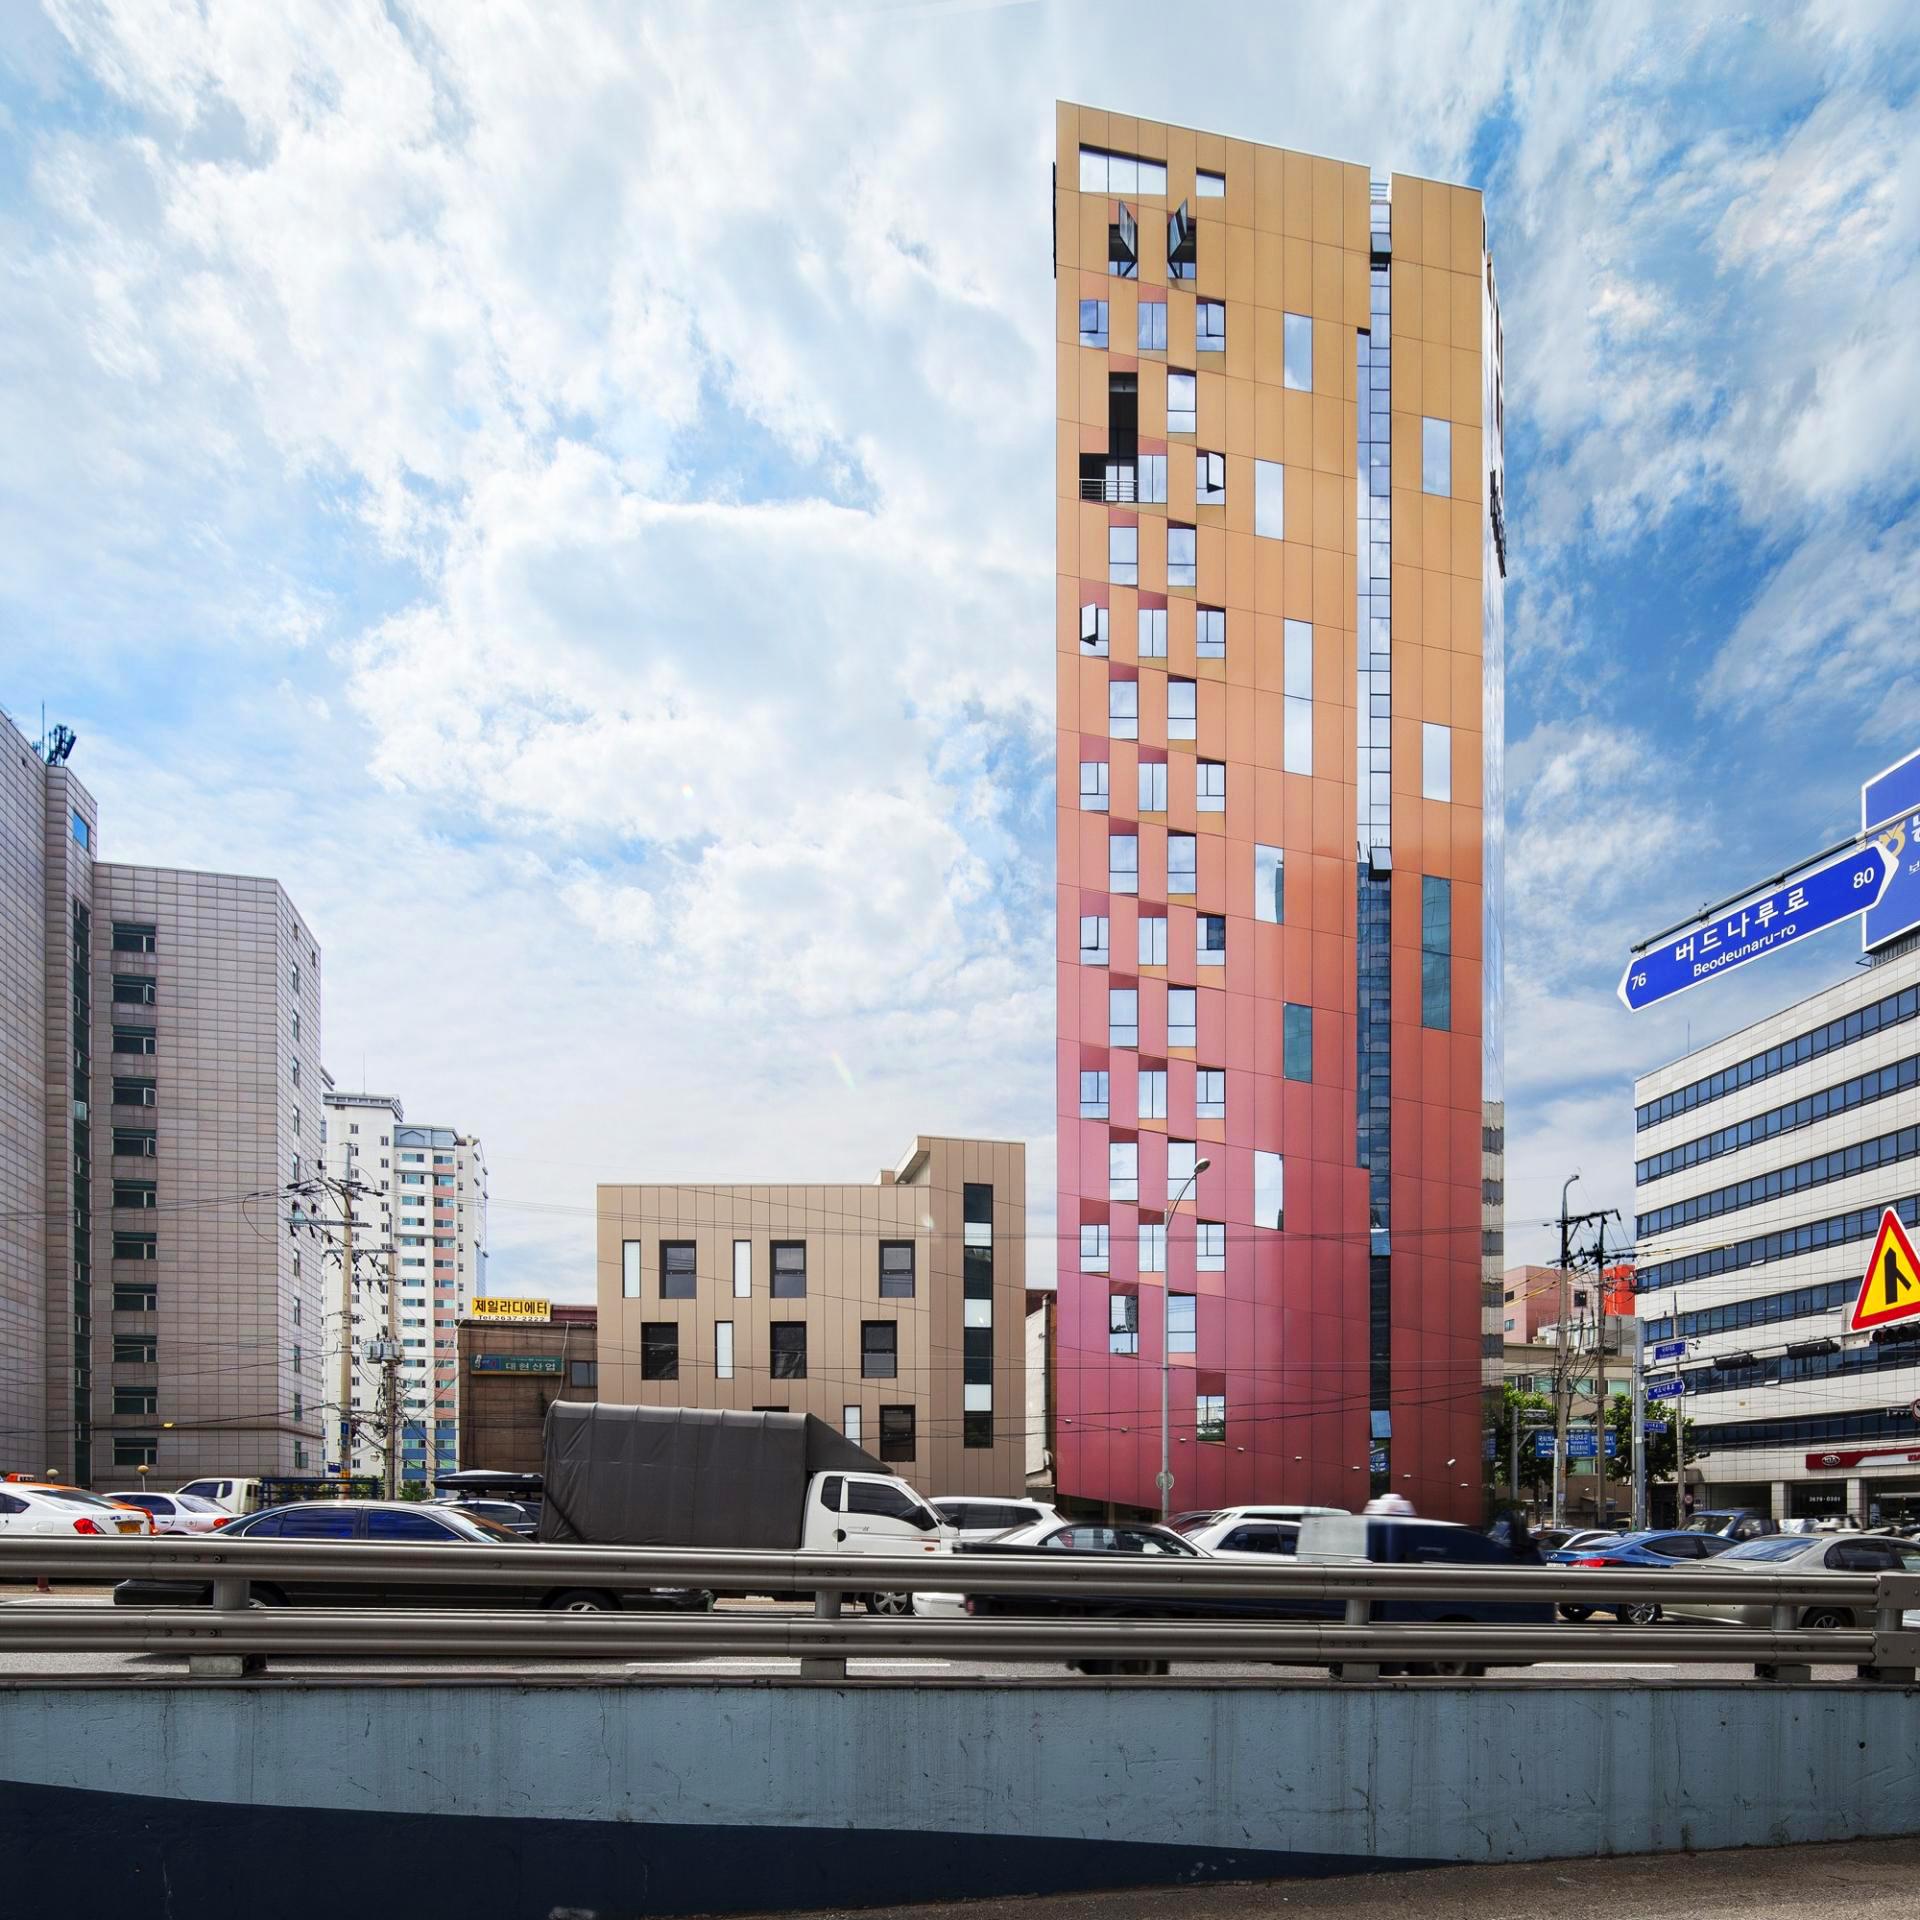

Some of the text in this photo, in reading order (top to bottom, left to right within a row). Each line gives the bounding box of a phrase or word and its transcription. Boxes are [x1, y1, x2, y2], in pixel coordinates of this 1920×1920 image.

[1853, 867, 1875, 889] 80
[1675, 887, 1809, 963] 버드나루로
[1693, 924, 1796, 977] Beodeunaru-ro
[1631, 972, 1647, 991] 76
[475, 1299, 548, 1314] 제일라디에터
